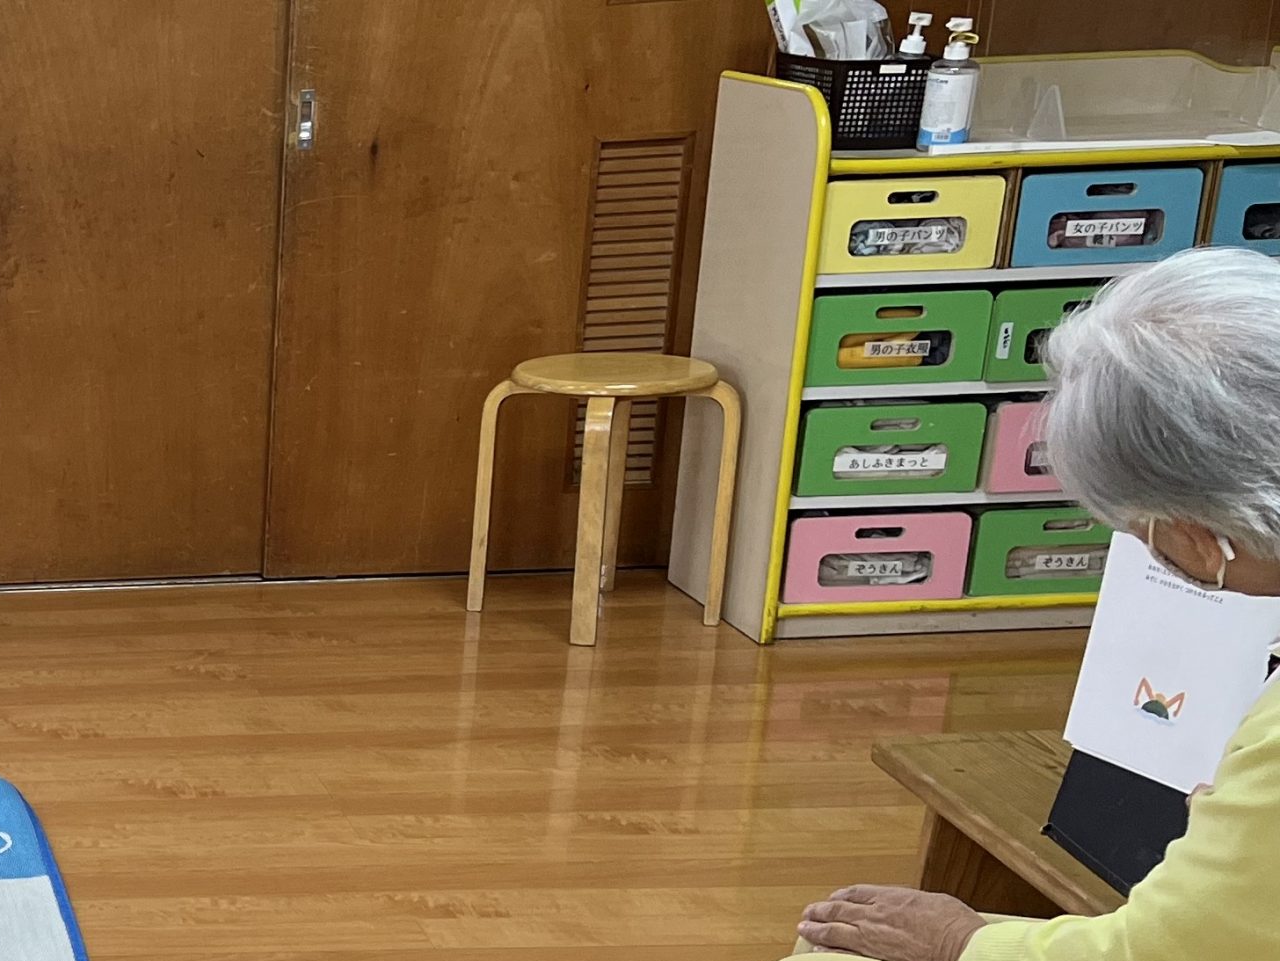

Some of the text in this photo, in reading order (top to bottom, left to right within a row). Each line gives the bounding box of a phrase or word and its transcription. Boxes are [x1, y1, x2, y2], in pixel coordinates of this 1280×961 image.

[1072, 221, 1143, 234] 女の子パンツ
[849, 456, 929, 469] あしふきまっと
[1042, 556, 1087, 568] ぞうきん
[855, 563, 899, 574] ぞうきん
